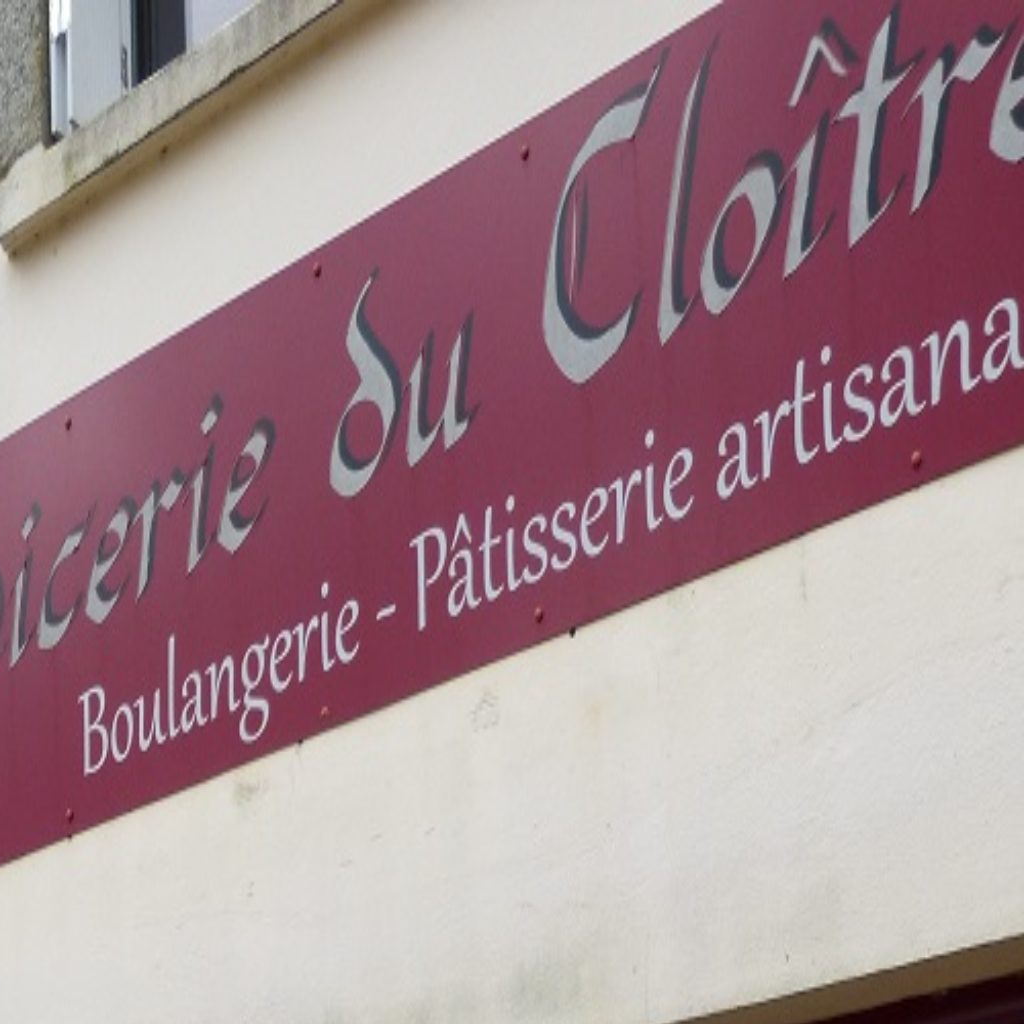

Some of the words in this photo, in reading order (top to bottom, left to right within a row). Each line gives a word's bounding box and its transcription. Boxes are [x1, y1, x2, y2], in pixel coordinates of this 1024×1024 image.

[329, 265, 478, 497] du
[78, 580, 361, 776] Boulangerie
[410, 431, 695, 631] Pâtisserie
